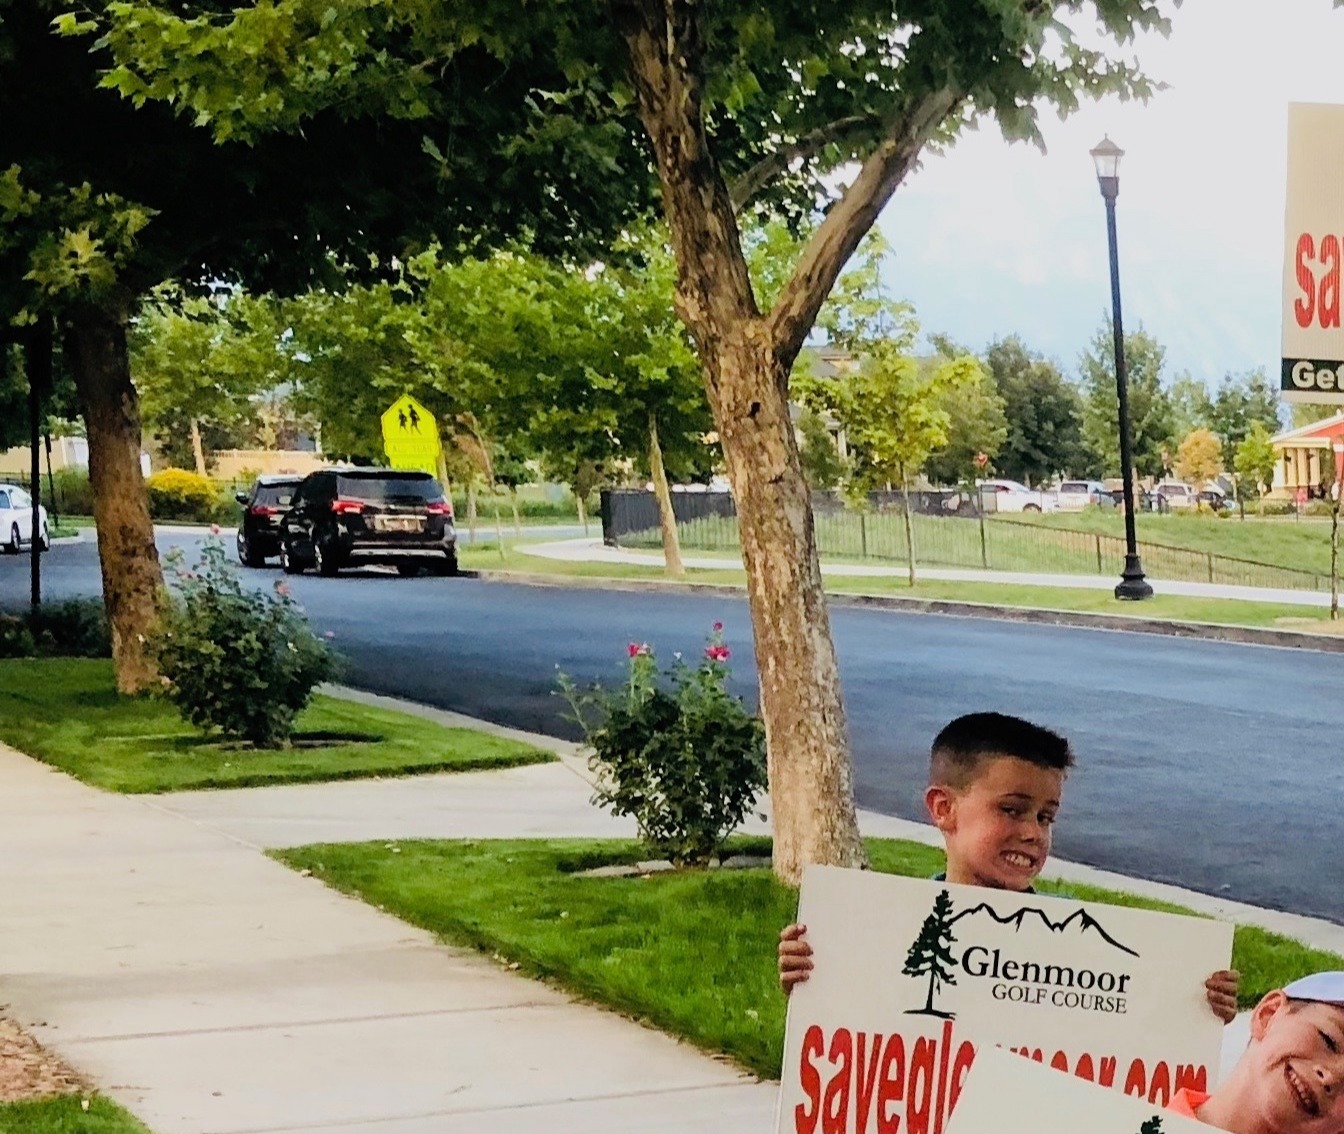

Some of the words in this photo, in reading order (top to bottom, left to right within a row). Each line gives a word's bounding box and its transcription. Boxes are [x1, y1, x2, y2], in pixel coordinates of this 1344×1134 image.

[961, 946, 1131, 994] Glenmoor
[992, 983, 1047, 1005] GOLF
[1051, 990, 1127, 1013] COURSE
